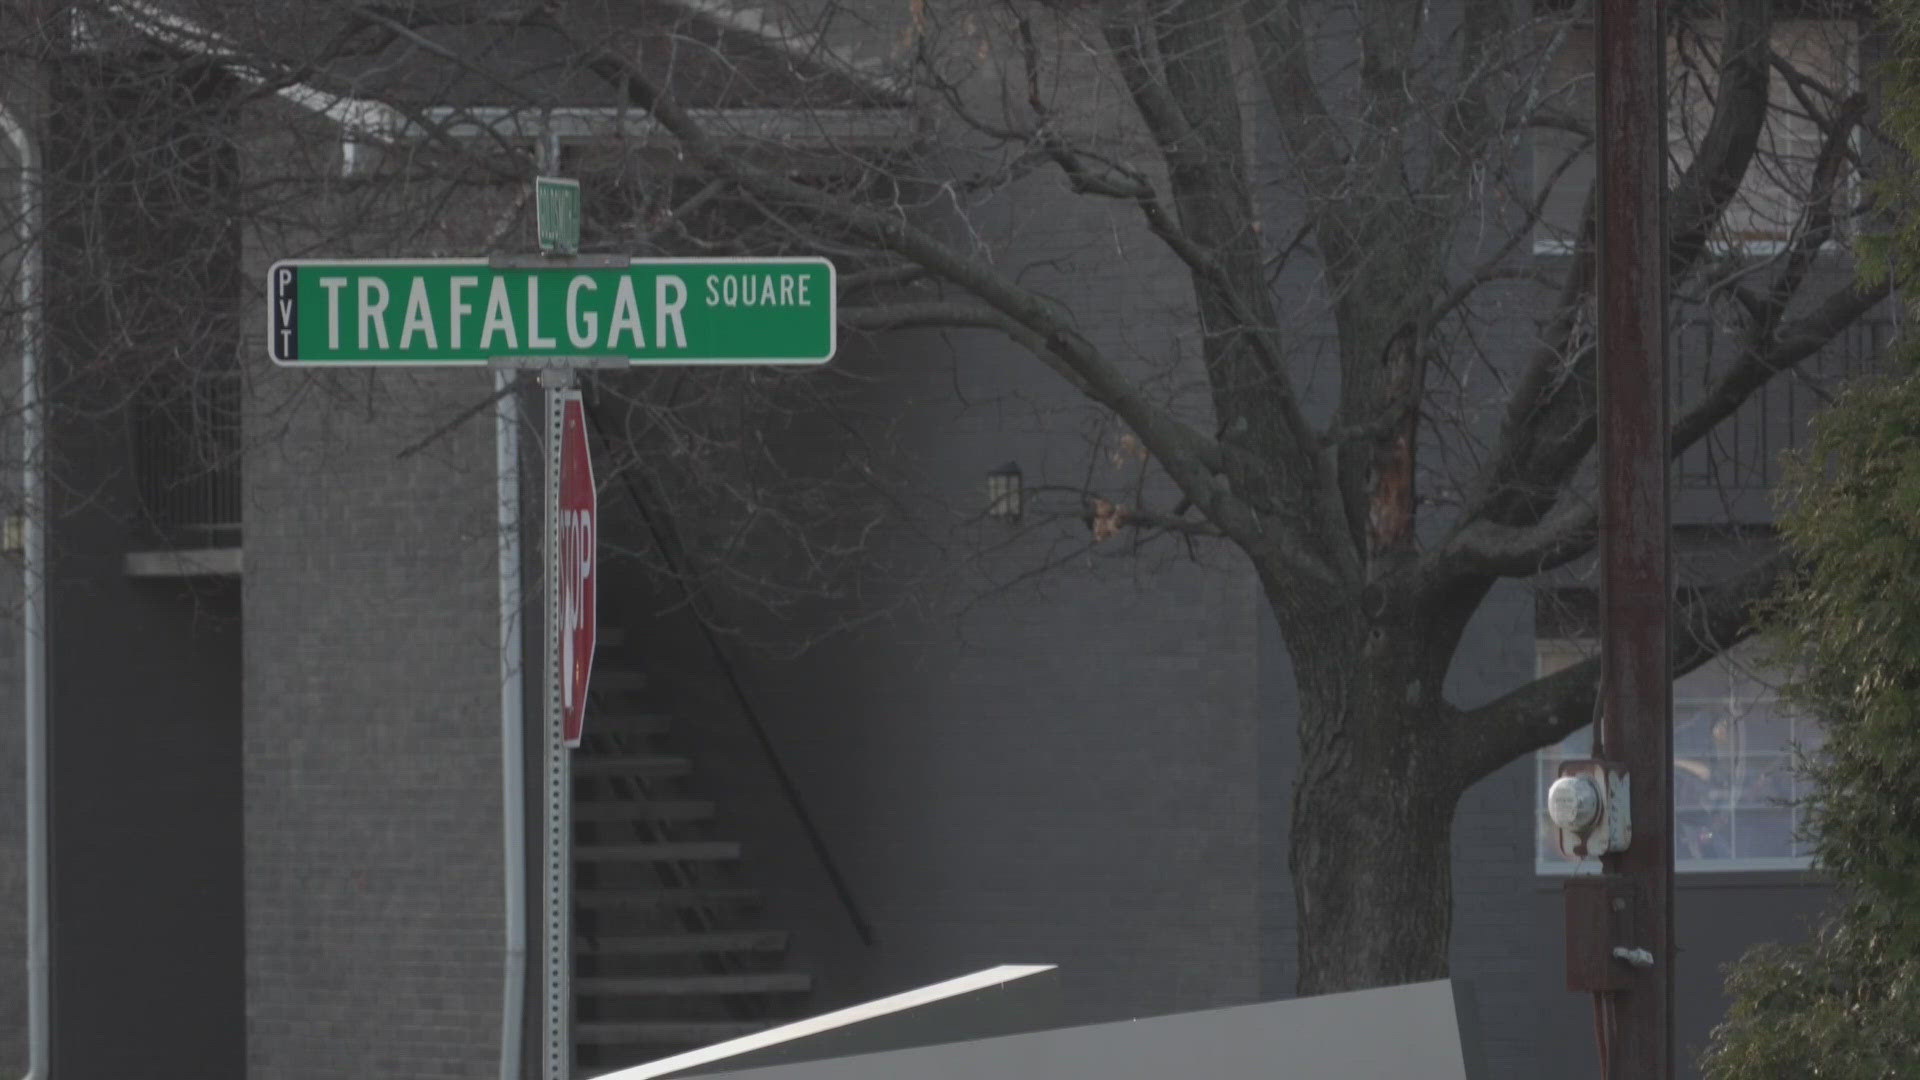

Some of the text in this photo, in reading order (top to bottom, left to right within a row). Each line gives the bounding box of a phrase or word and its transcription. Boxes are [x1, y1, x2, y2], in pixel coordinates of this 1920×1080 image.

[279, 269, 293, 358] PVT
[320, 275, 812, 350] TRAFALGAR SQUARE
